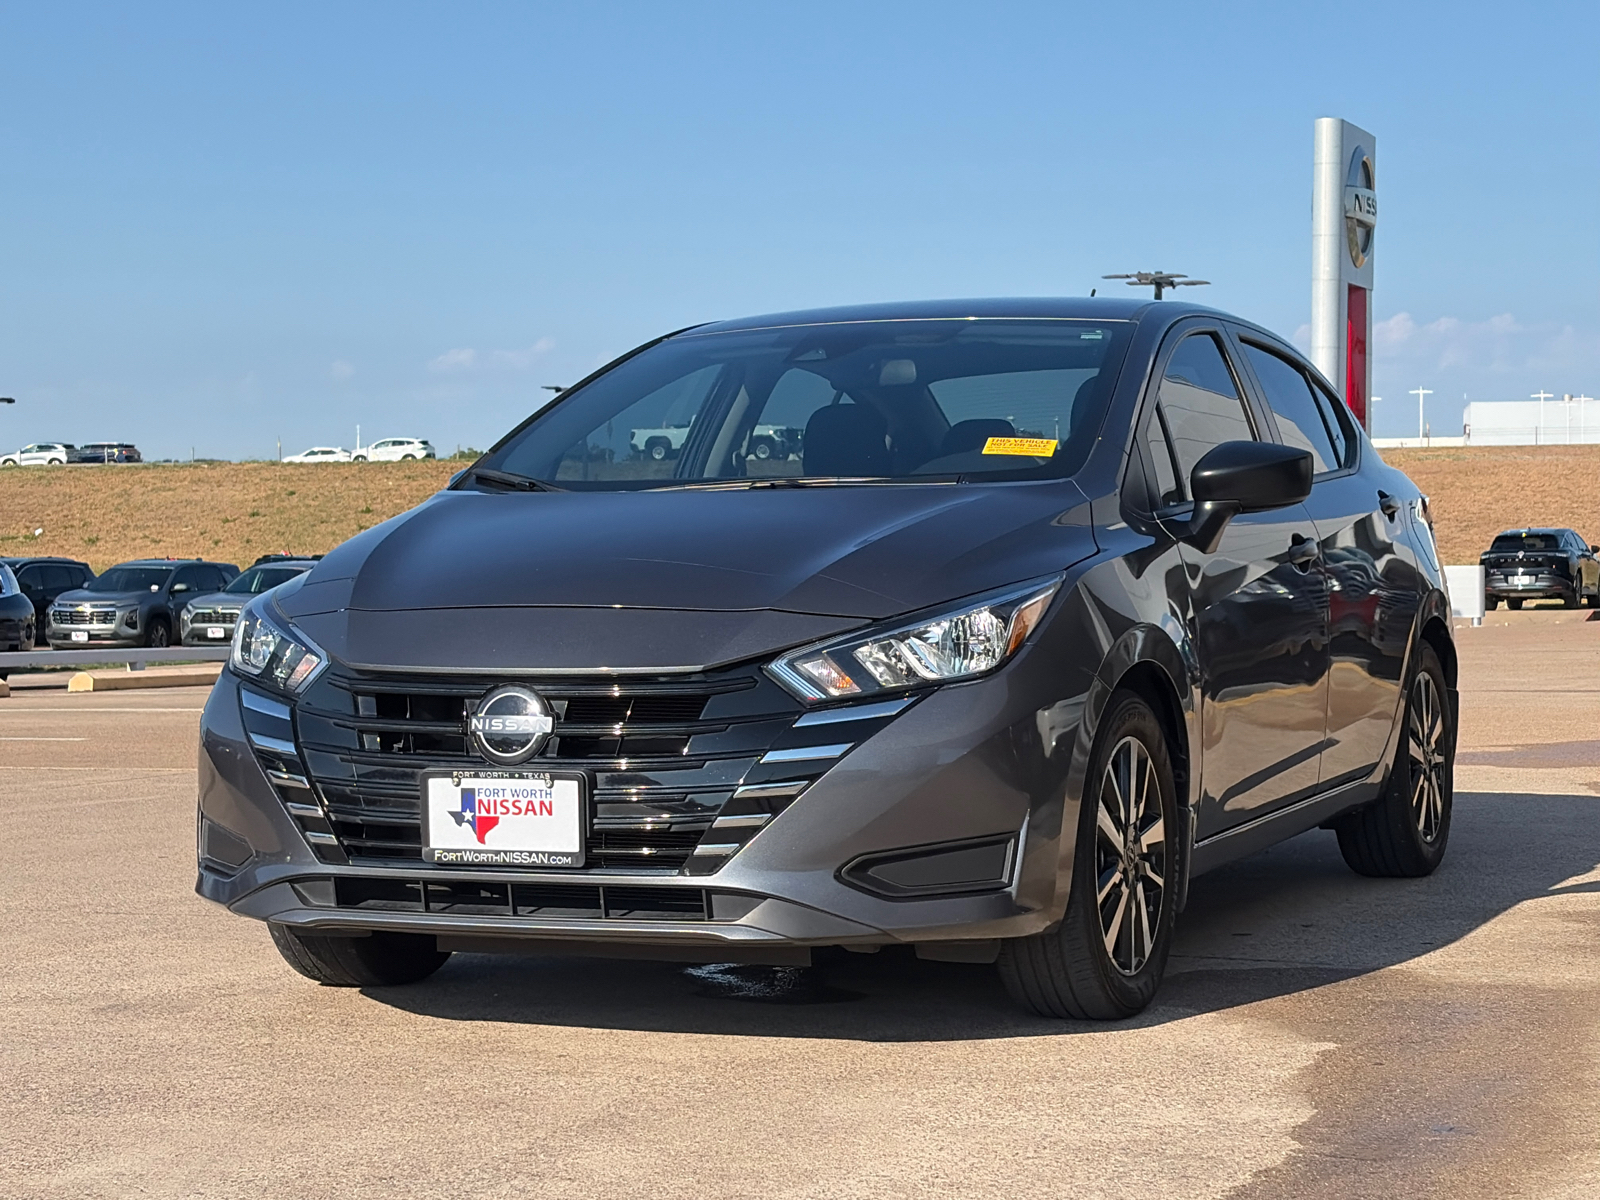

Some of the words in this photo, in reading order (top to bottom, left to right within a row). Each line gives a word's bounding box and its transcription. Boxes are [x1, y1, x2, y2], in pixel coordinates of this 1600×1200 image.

[471, 718, 550, 731] NISSAN
[452, 771, 475, 779] FORT
[522, 772, 551, 780] TEXAS
[477, 787, 507, 798] FORT
[510, 788, 553, 799] WORTH
[477, 799, 553, 816] NISSAN
